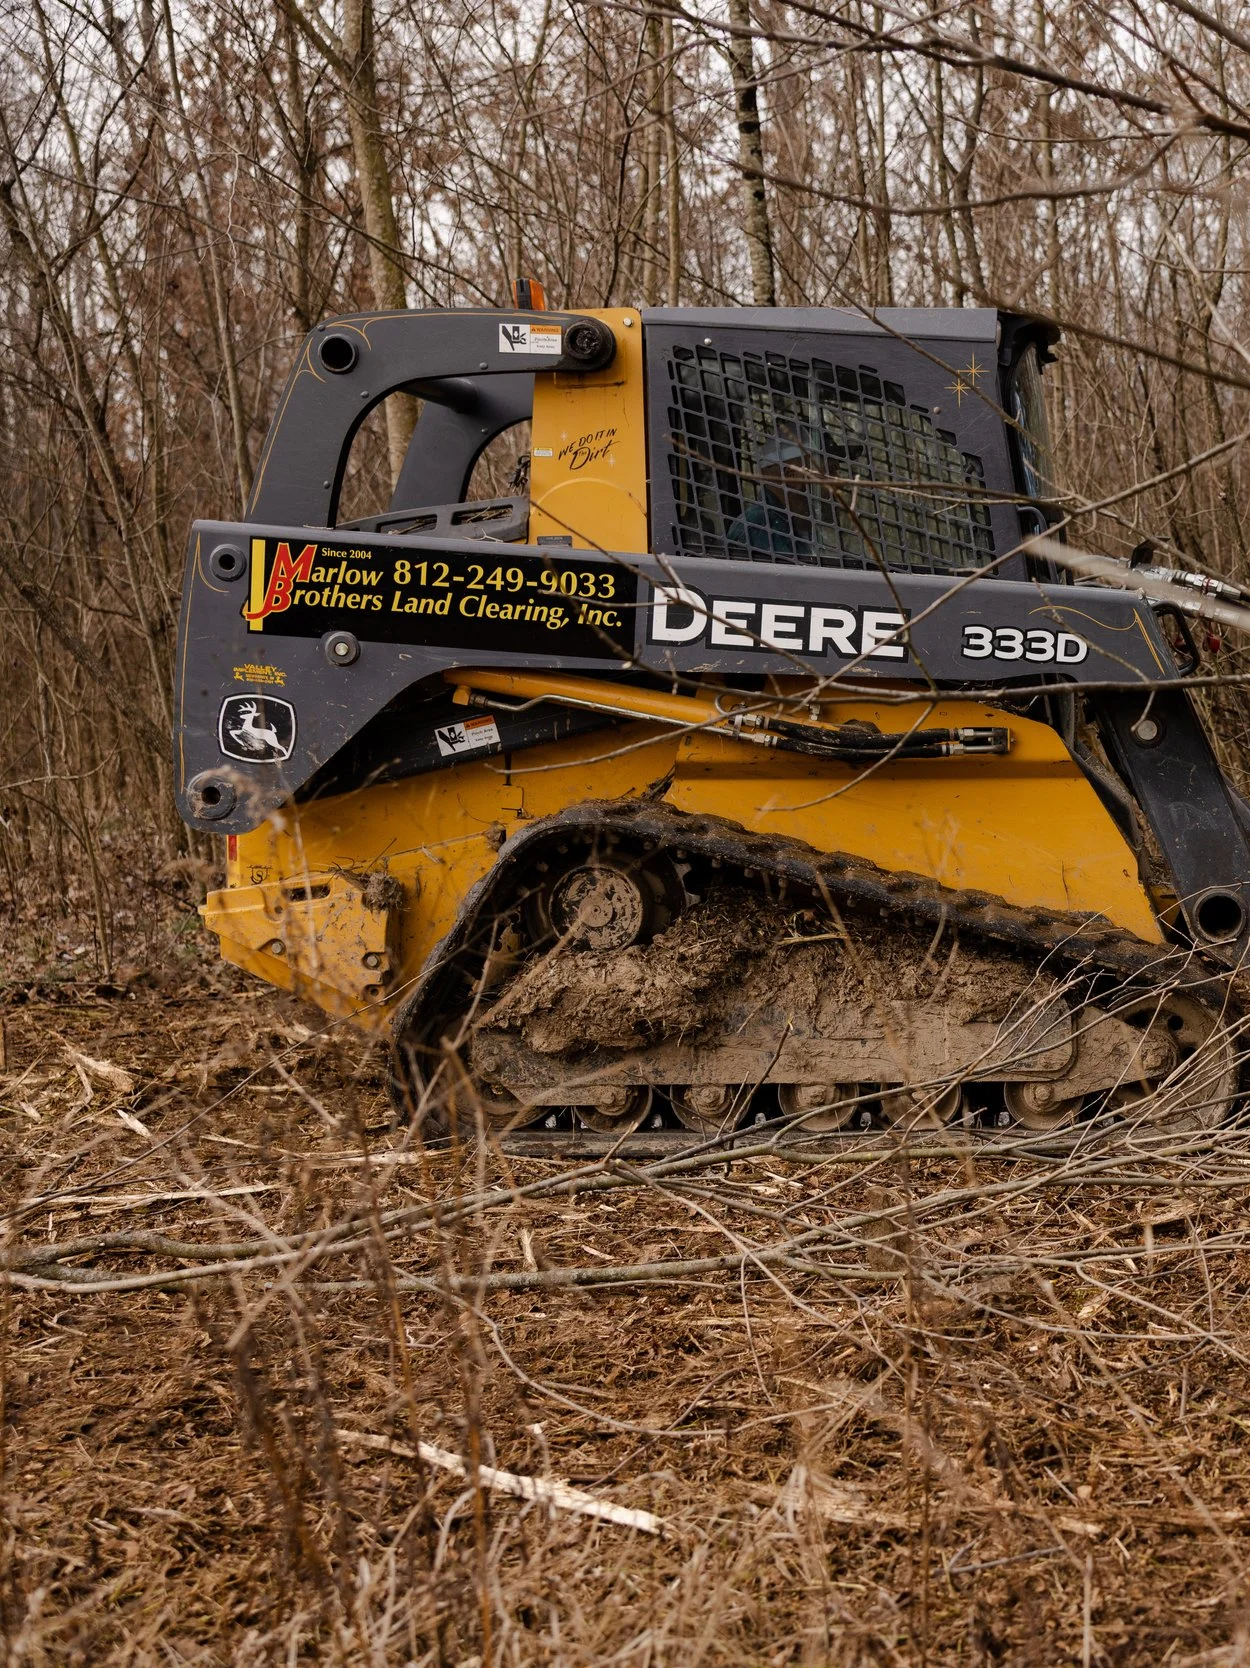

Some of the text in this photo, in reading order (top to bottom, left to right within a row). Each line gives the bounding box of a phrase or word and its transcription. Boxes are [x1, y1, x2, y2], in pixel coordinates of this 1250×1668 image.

[558, 441, 576, 460] WE
[579, 434, 594, 447] DO
[595, 430, 606, 441] IT
[606, 428, 617, 437] IN
[569, 440, 620, 470] Dirt
[270, 542, 616, 599] Marlow 812-249-9033
[321, 547, 372, 560] Since 2004
[260, 578, 622, 630] Brothers Land Clearing, Inc.
[651, 585, 906, 658] DEERE
[963, 625, 1088, 663] 333D
